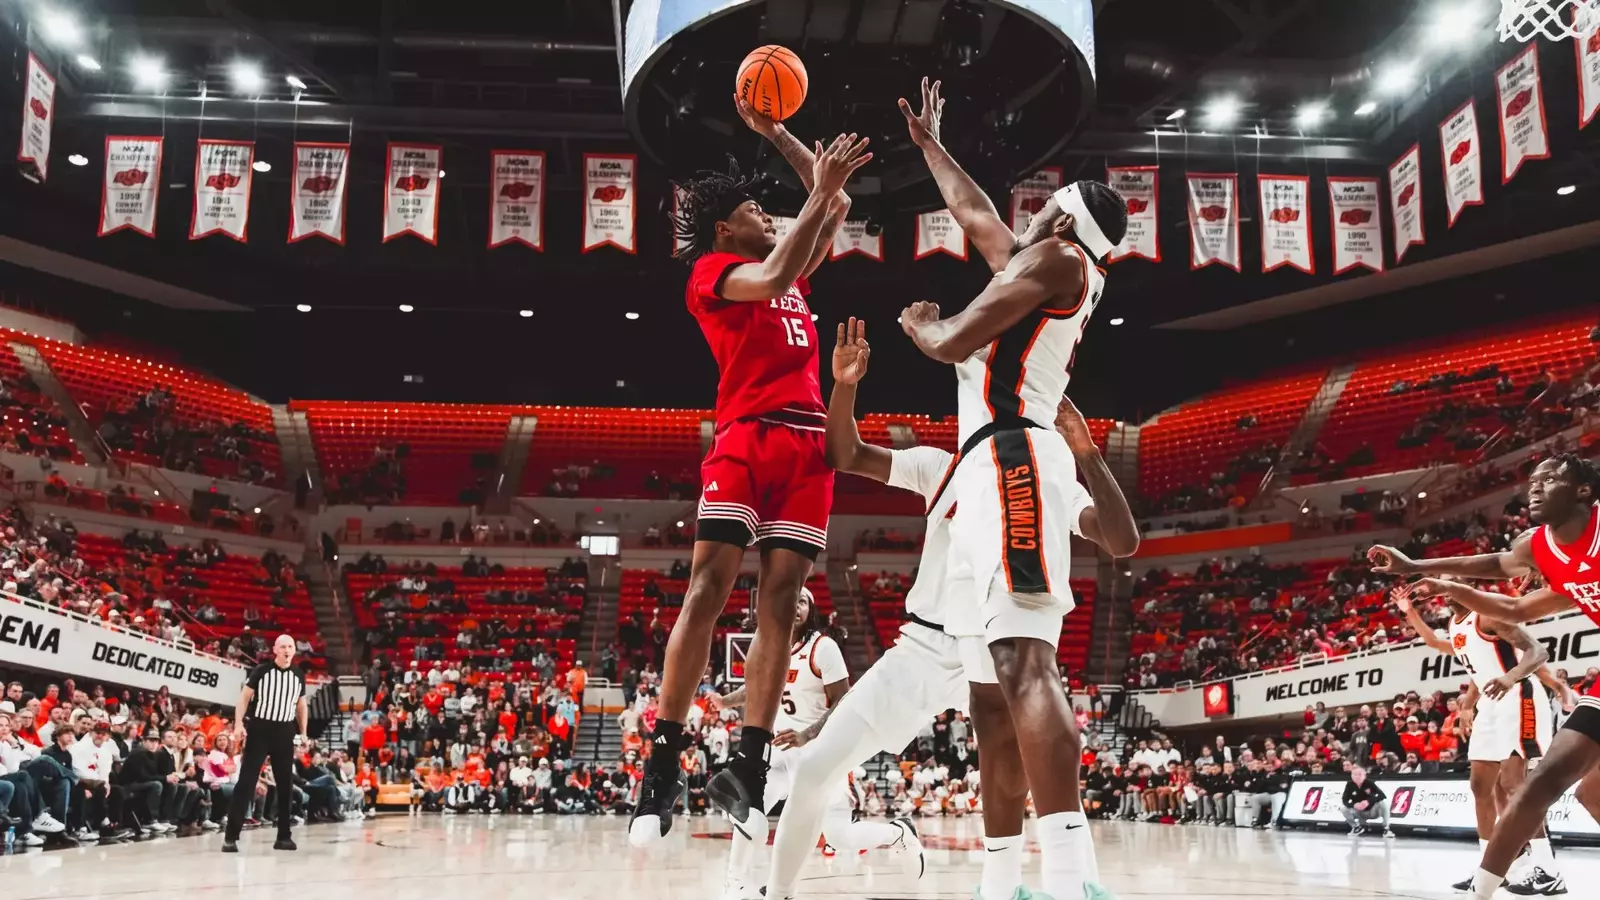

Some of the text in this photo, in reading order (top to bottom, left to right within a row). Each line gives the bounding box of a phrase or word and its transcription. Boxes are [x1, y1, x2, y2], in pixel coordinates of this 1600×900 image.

[781, 317, 809, 347] 15
[1005, 464, 1037, 550] COWBOYS
[0, 613, 61, 655] ENA
[92, 641, 220, 689] DEDICATED 1938
[1265, 673, 1350, 702] WELCOME
[1355, 668, 1384, 688] TO
[1418, 789, 1469, 803] Simmons
[1547, 806, 1572, 822] ank
